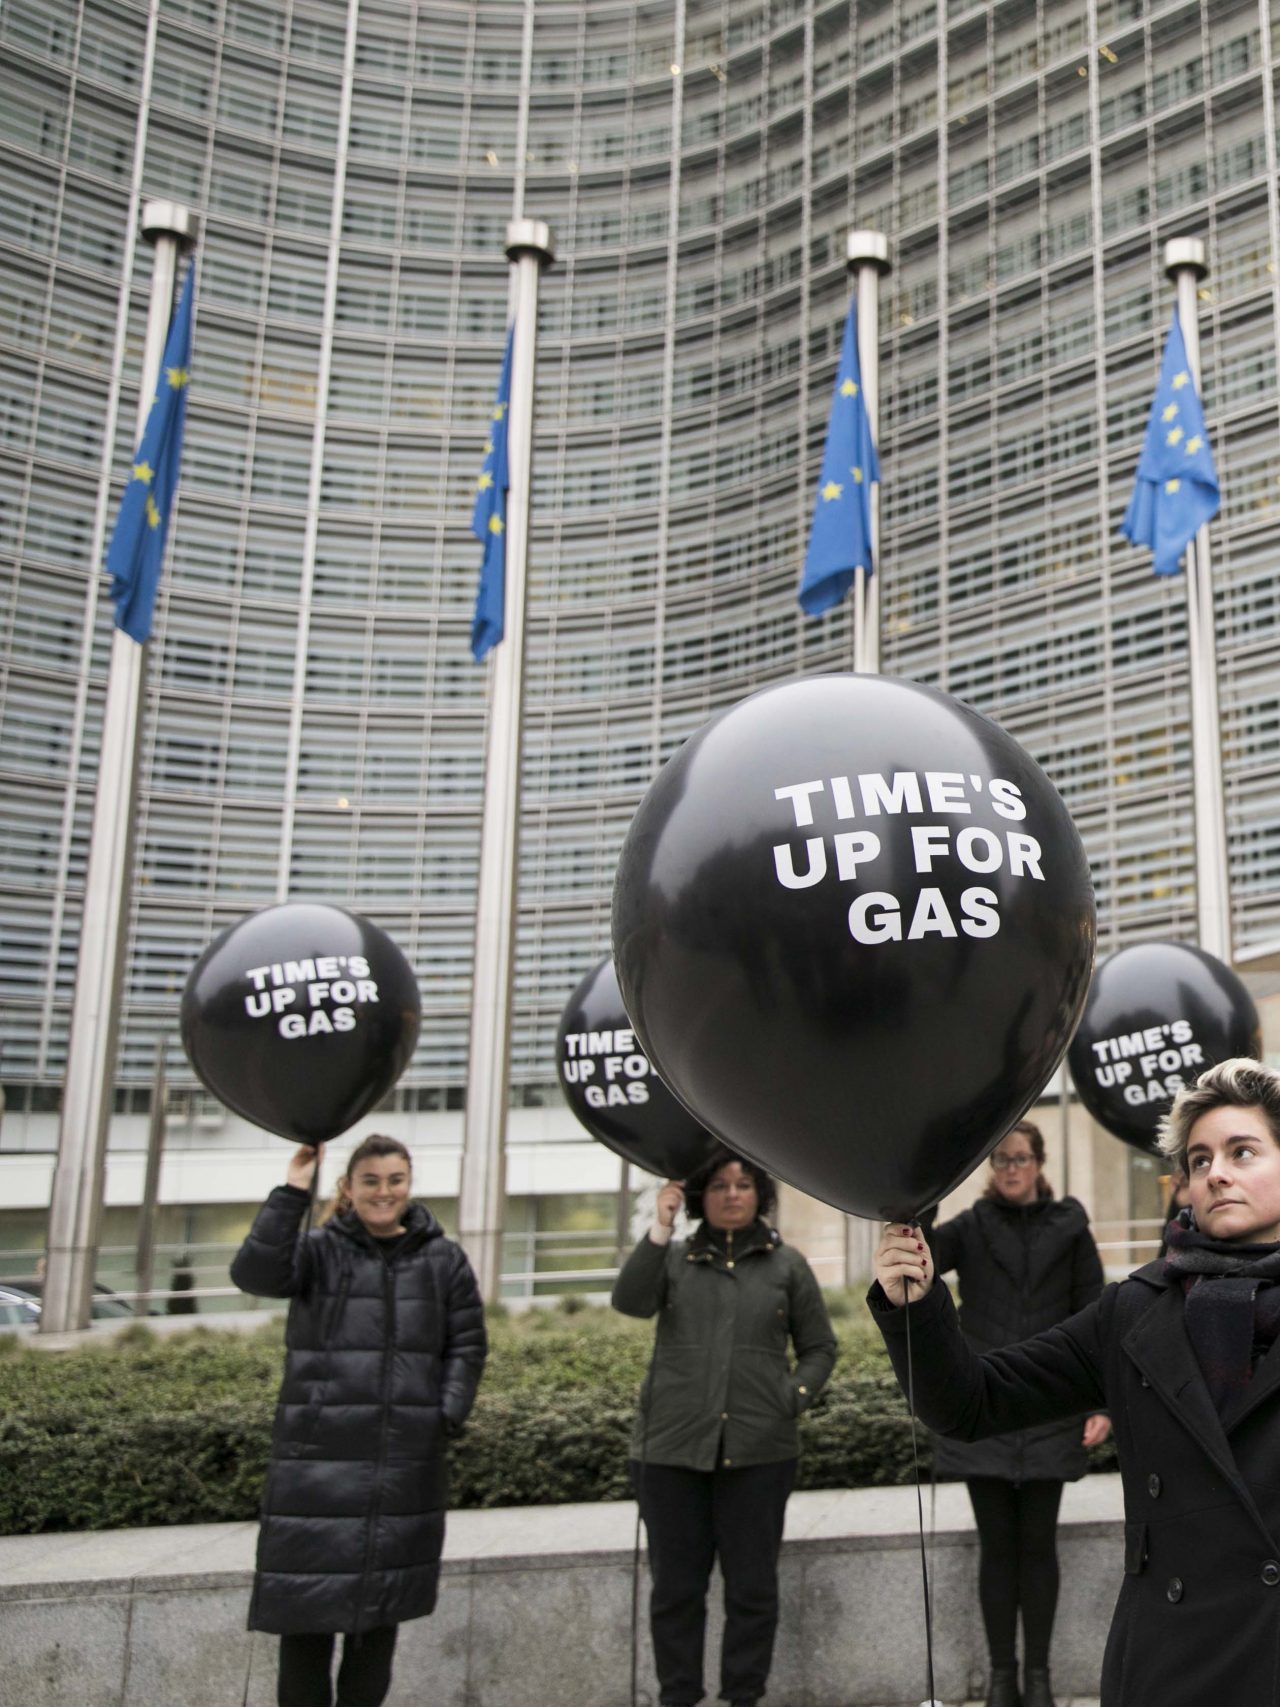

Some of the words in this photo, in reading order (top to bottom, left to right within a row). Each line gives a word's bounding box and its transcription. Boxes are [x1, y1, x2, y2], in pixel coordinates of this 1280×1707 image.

[774, 771, 1027, 827] TIME'S
[773, 830, 881, 889] UP
[911, 825, 1046, 881] FOR
[848, 886, 1000, 945] GAS
[245, 956, 371, 990] TIME'S
[245, 987, 296, 1018] UP
[308, 980, 380, 1007] FOR
[279, 1007, 357, 1039] GAS
[565, 1029, 635, 1057] TIME
[1092, 1020, 1193, 1063] TIME'S
[563, 1059, 595, 1083] UP
[604, 1054, 658, 1081] FO
[1095, 1061, 1132, 1087] UP
[1140, 1043, 1205, 1078] FOR
[584, 1081, 650, 1108] GAS
[1123, 1074, 1186, 1106] GAS
